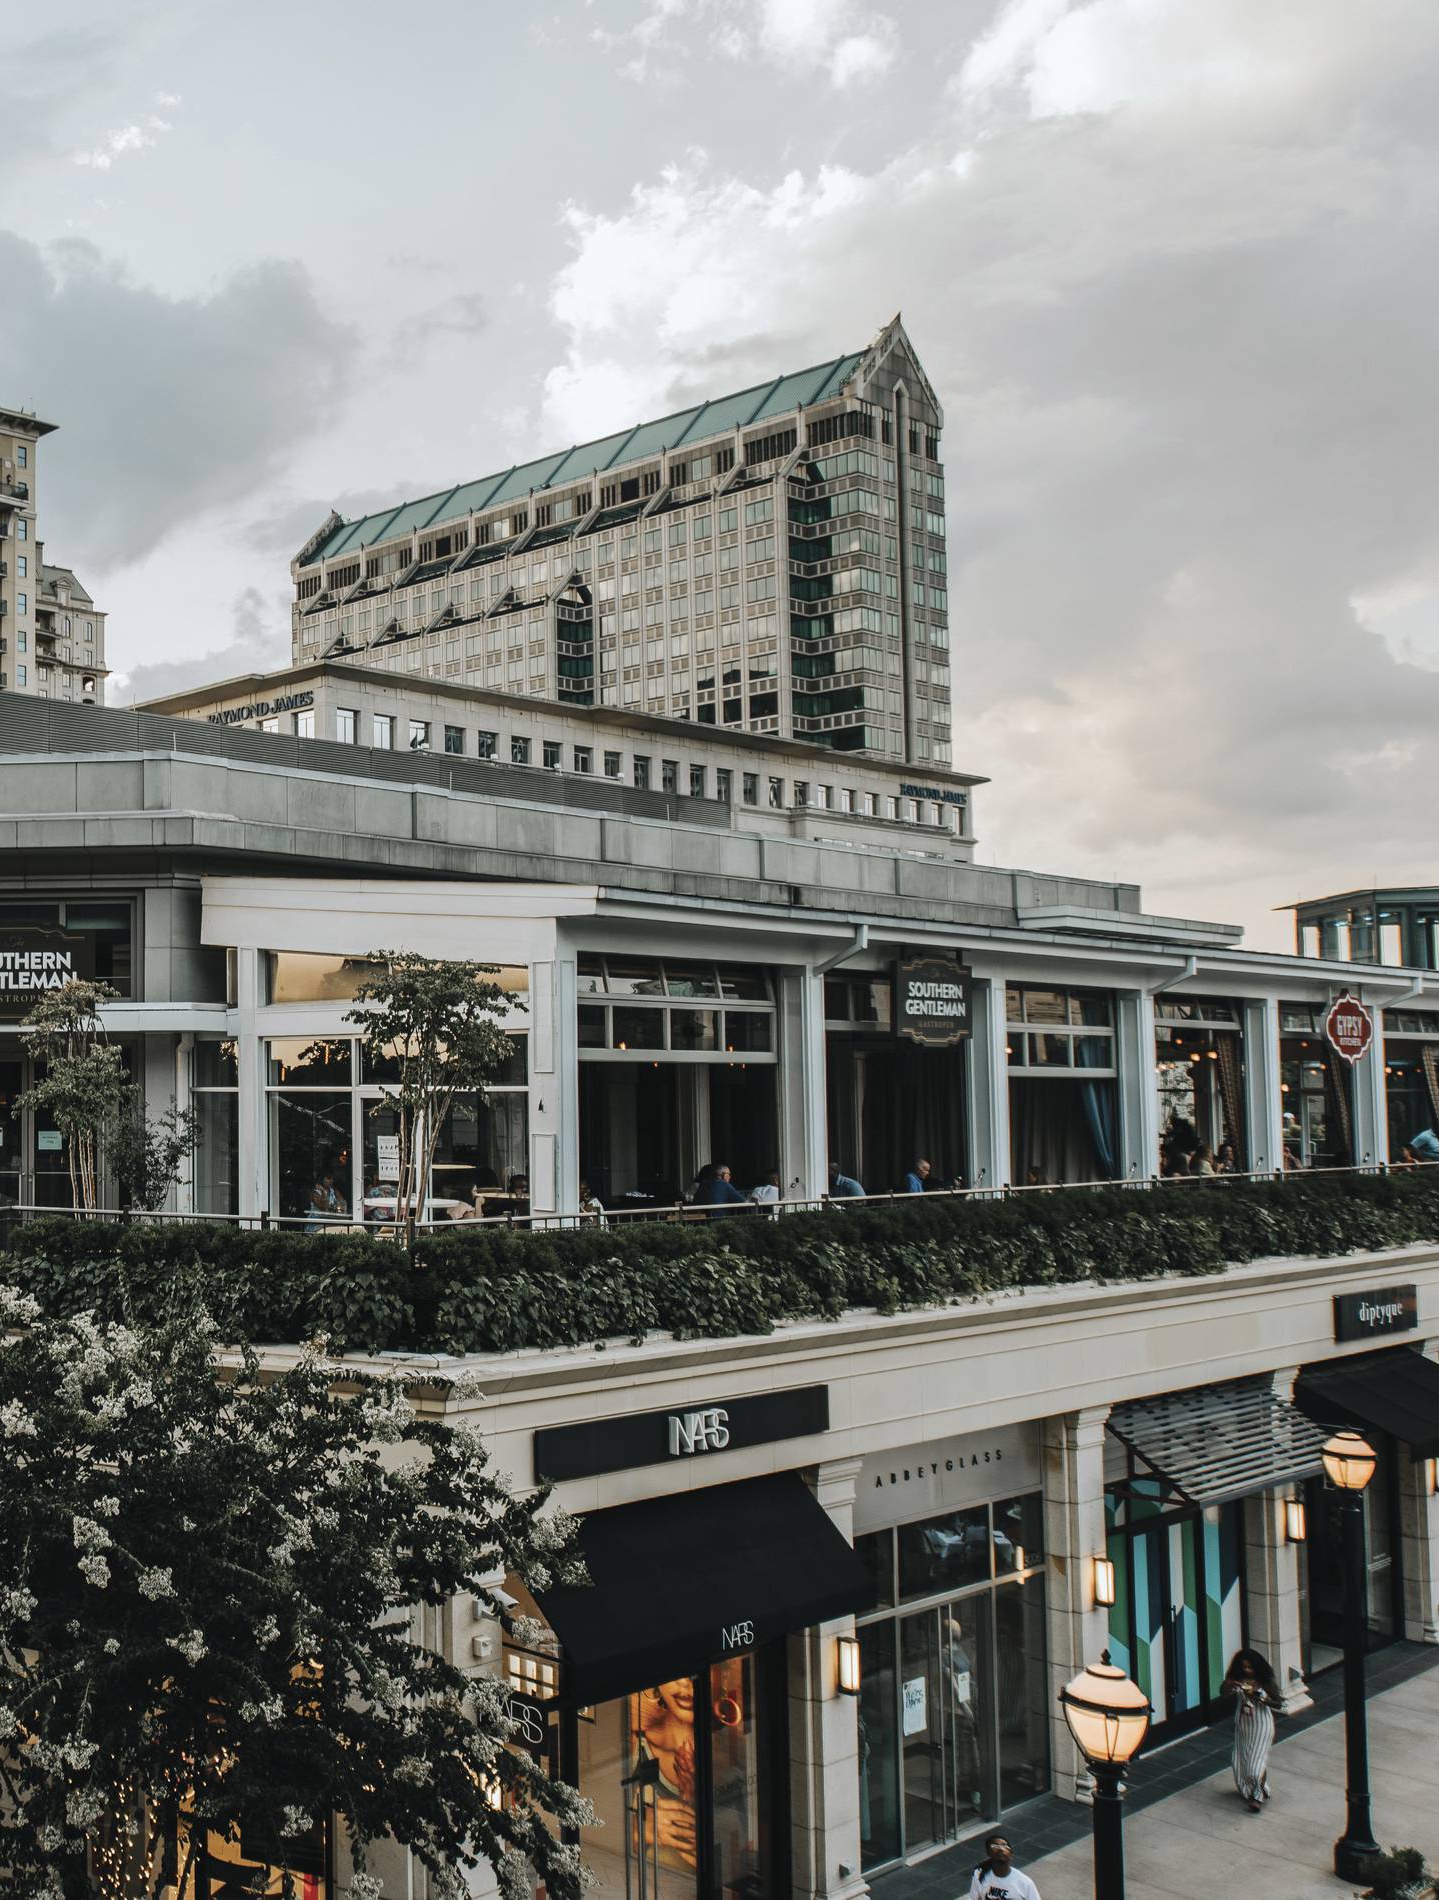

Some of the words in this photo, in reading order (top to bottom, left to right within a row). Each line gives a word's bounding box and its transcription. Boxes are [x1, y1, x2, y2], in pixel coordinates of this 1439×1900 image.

[208, 702, 269, 724] RAYMOND
[271, 691, 314, 714] JAMES
[908, 981, 963, 999] SOUTHERN
[905, 999, 966, 1017] GENTLEMAN
[1336, 1015, 1362, 1036] GYPSY
[1359, 1302, 1403, 1326] diptyque
[668, 1408, 730, 1456] NARS
[722, 1620, 754, 1651] NARS
[989, 1886, 1009, 1897] NIKE
